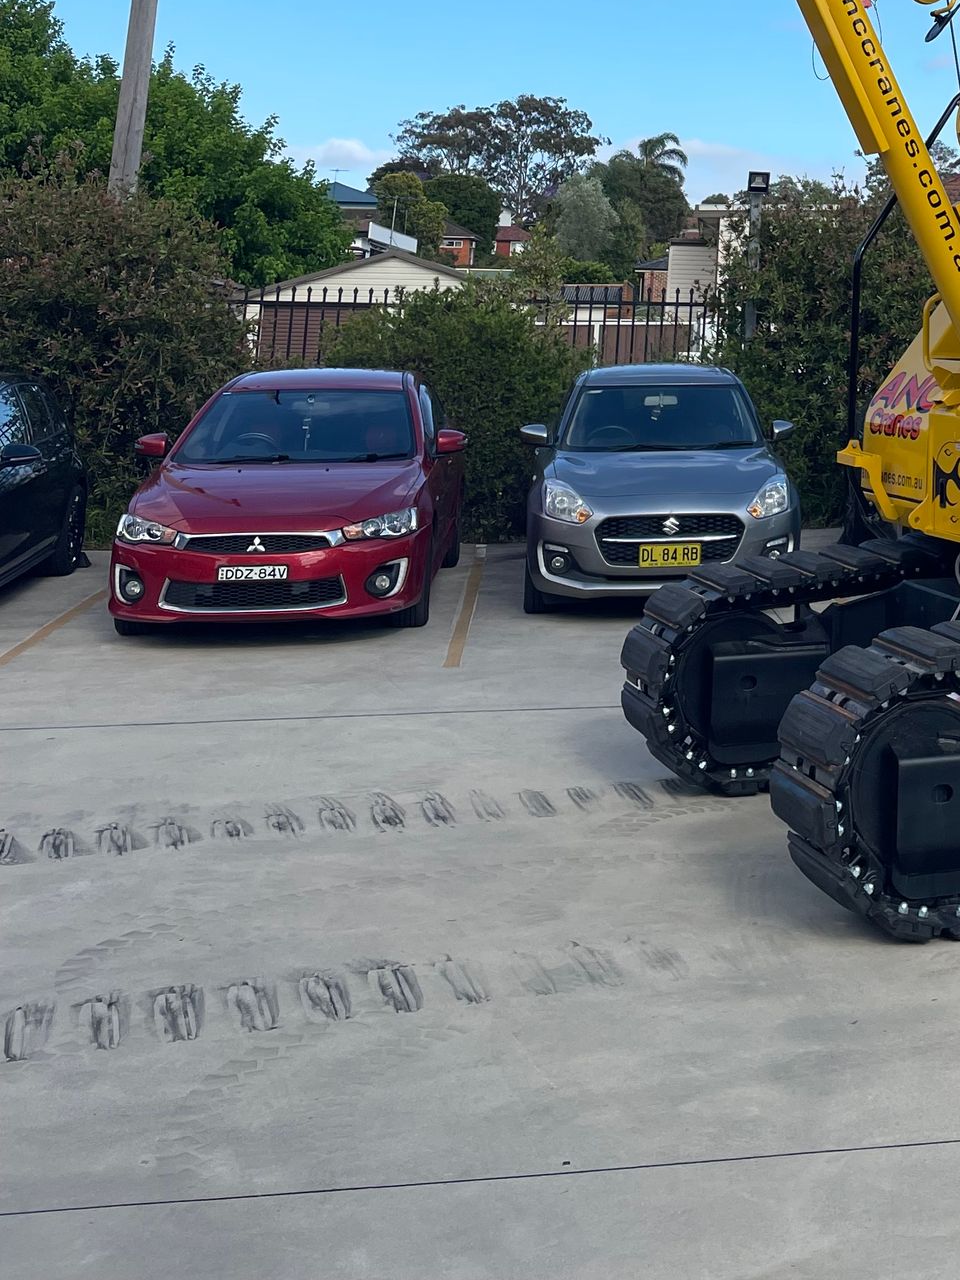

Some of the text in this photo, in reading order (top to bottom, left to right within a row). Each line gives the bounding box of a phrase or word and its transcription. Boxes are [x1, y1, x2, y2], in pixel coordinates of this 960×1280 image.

[870, 371, 938, 414] ANC
[870, 407, 922, 440] Cranes
[641, 546, 698, 563] DL 84 RB
